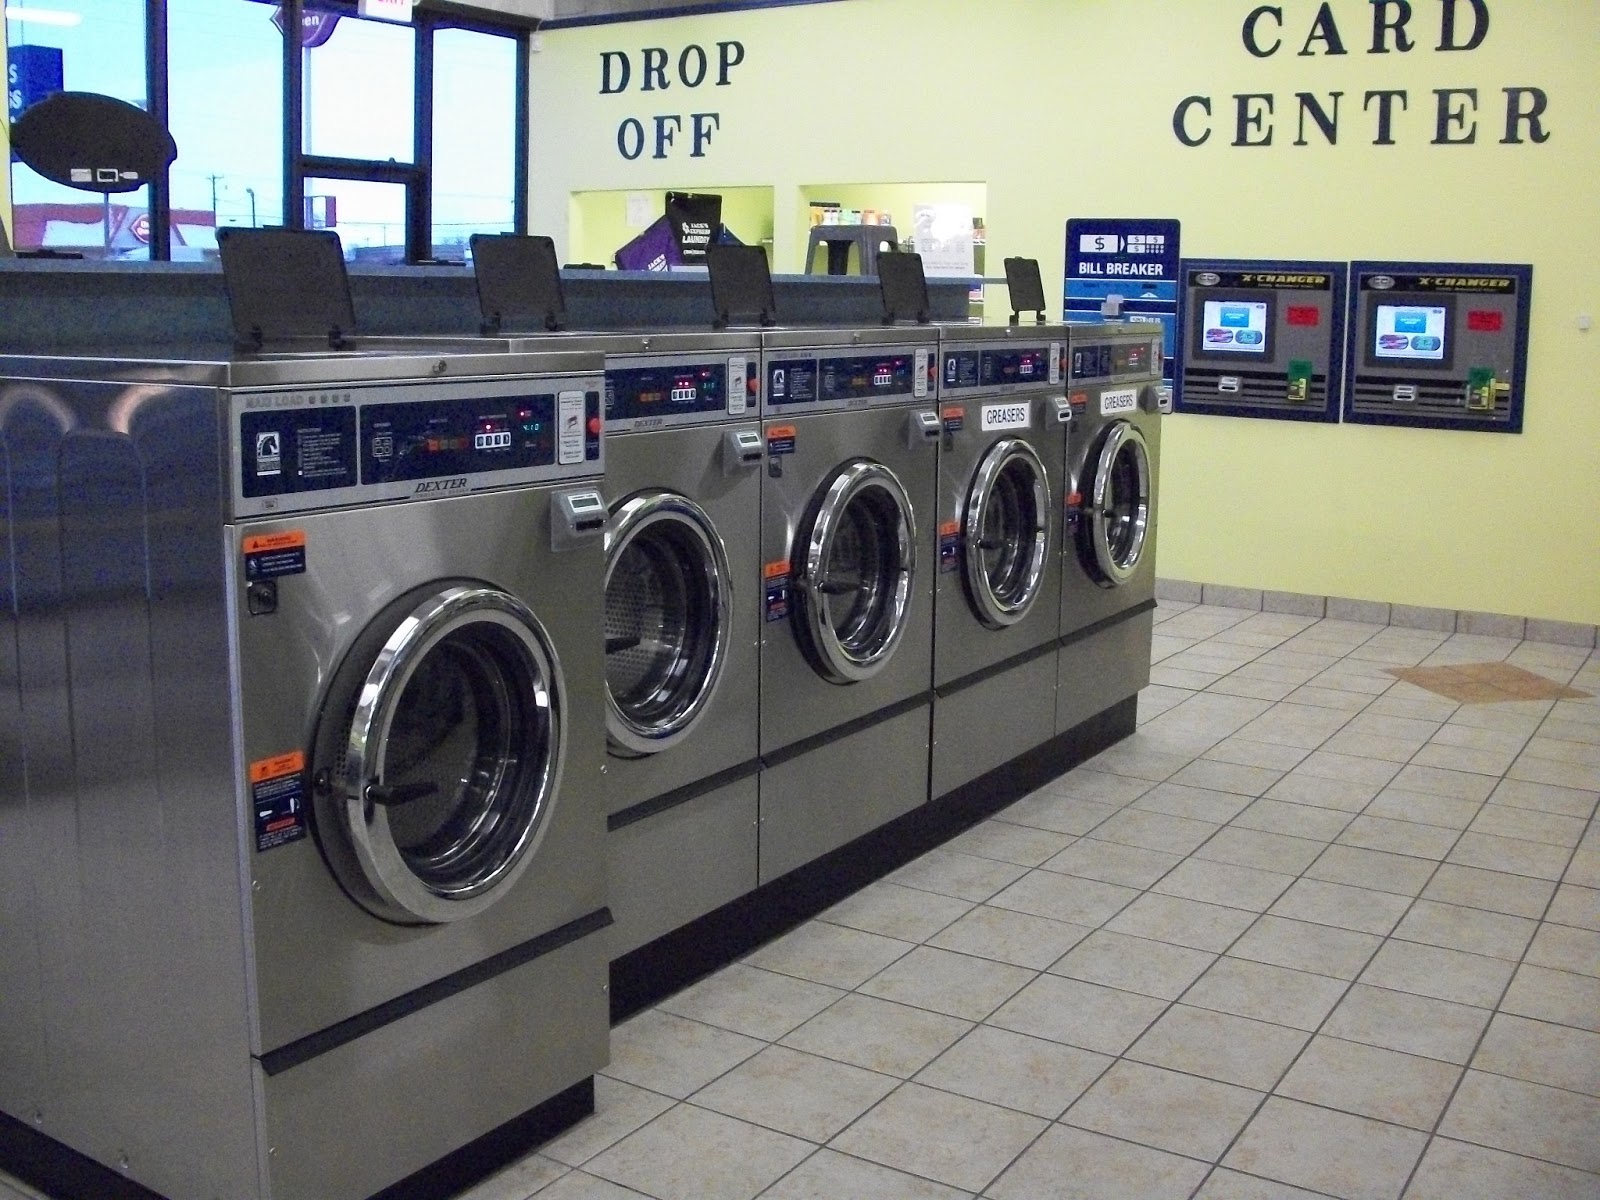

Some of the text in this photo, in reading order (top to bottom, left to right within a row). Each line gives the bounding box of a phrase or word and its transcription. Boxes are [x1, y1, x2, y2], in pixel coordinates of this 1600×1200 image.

[1242, 0, 1491, 58] CARD
[599, 40, 745, 94] DROP
[1172, 87, 1551, 147] CENTER
[617, 112, 720, 160] OFF
[1078, 262, 1163, 275] BILL BREAKER
[986, 407, 1025, 425] GREASERS
[1104, 393, 1134, 409] GREASERS
[415, 477, 467, 493] DEXTER
